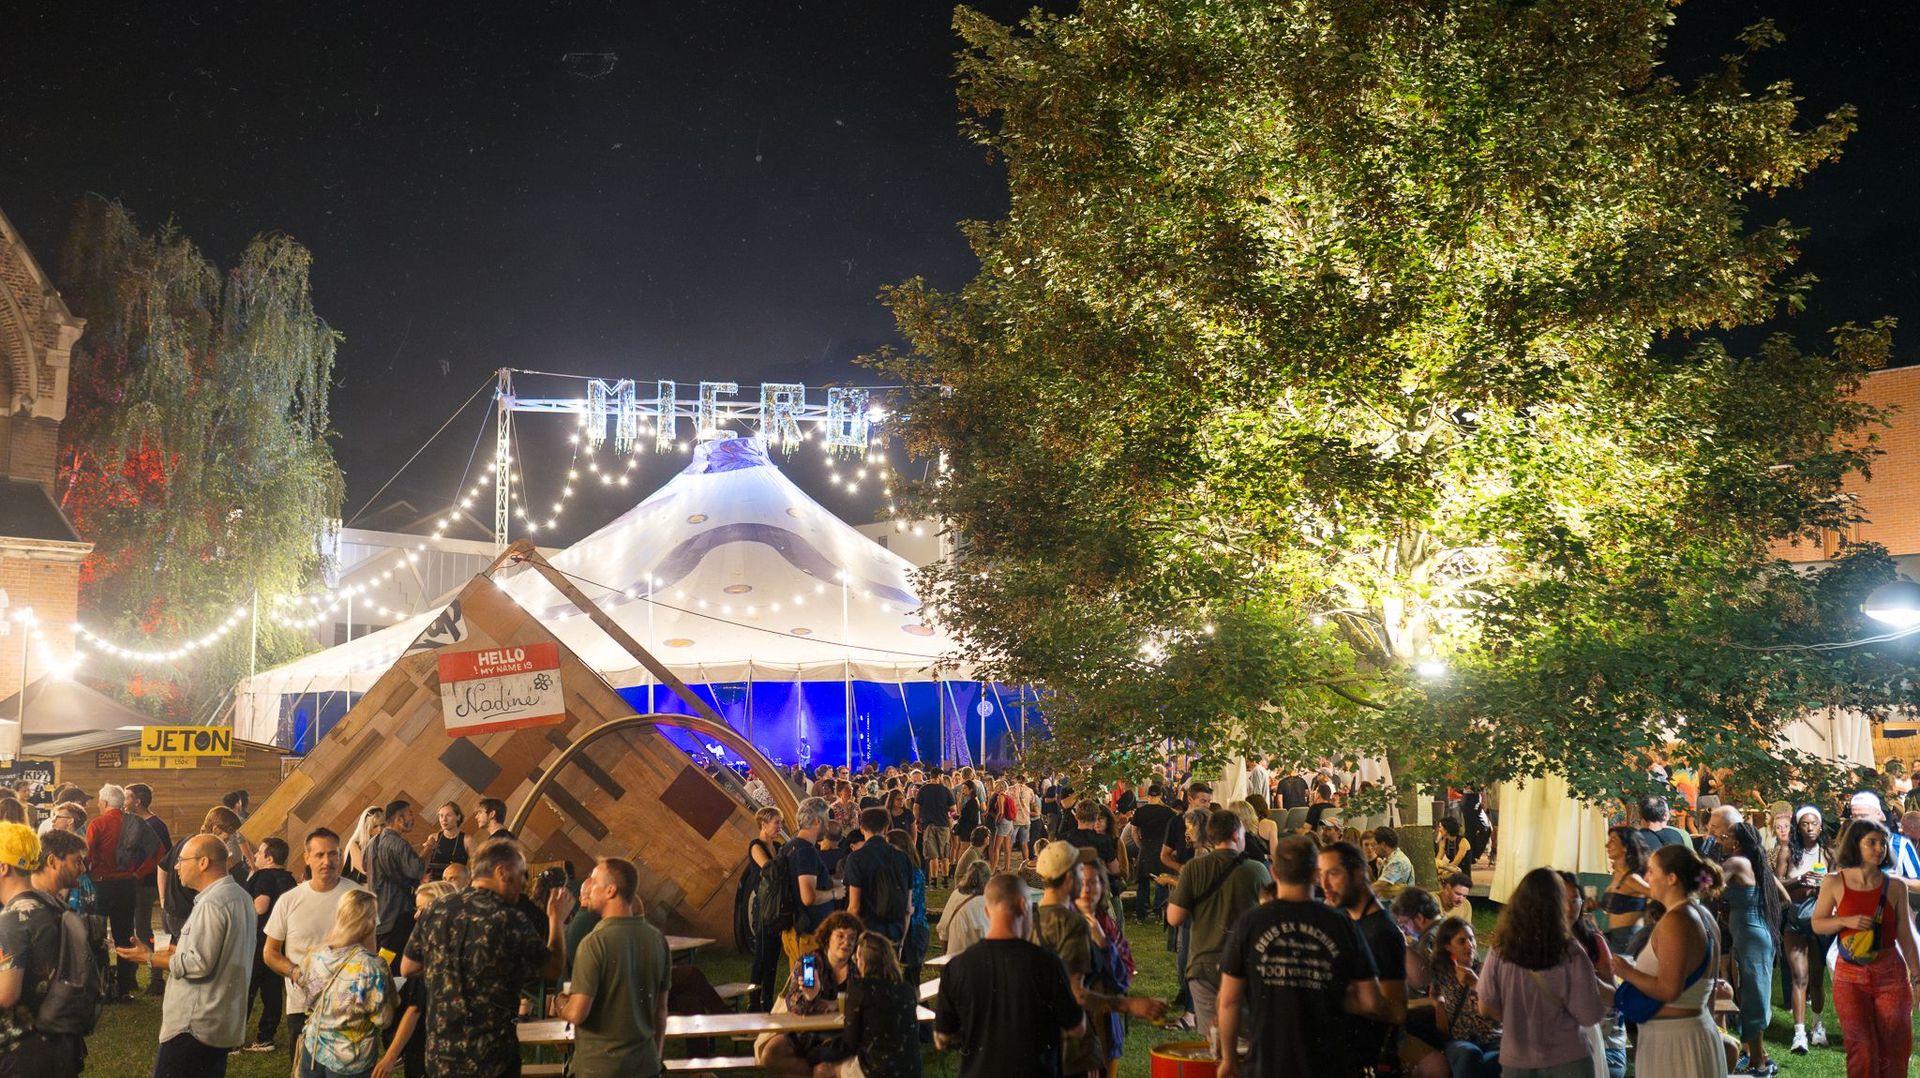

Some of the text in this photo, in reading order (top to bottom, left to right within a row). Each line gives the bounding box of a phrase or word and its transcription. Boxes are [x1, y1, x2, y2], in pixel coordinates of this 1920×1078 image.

[586, 378, 871, 454] MICRO
[478, 648, 525, 666] HELLO
[480, 667, 494, 675] MY
[496, 663, 522, 673] NAME
[523, 661, 533, 670] IS
[456, 683, 539, 717] Nadine
[147, 730, 230, 752] JETON
[1255, 926, 1280, 953] DEUS
[1281, 922, 1296, 934] EX
